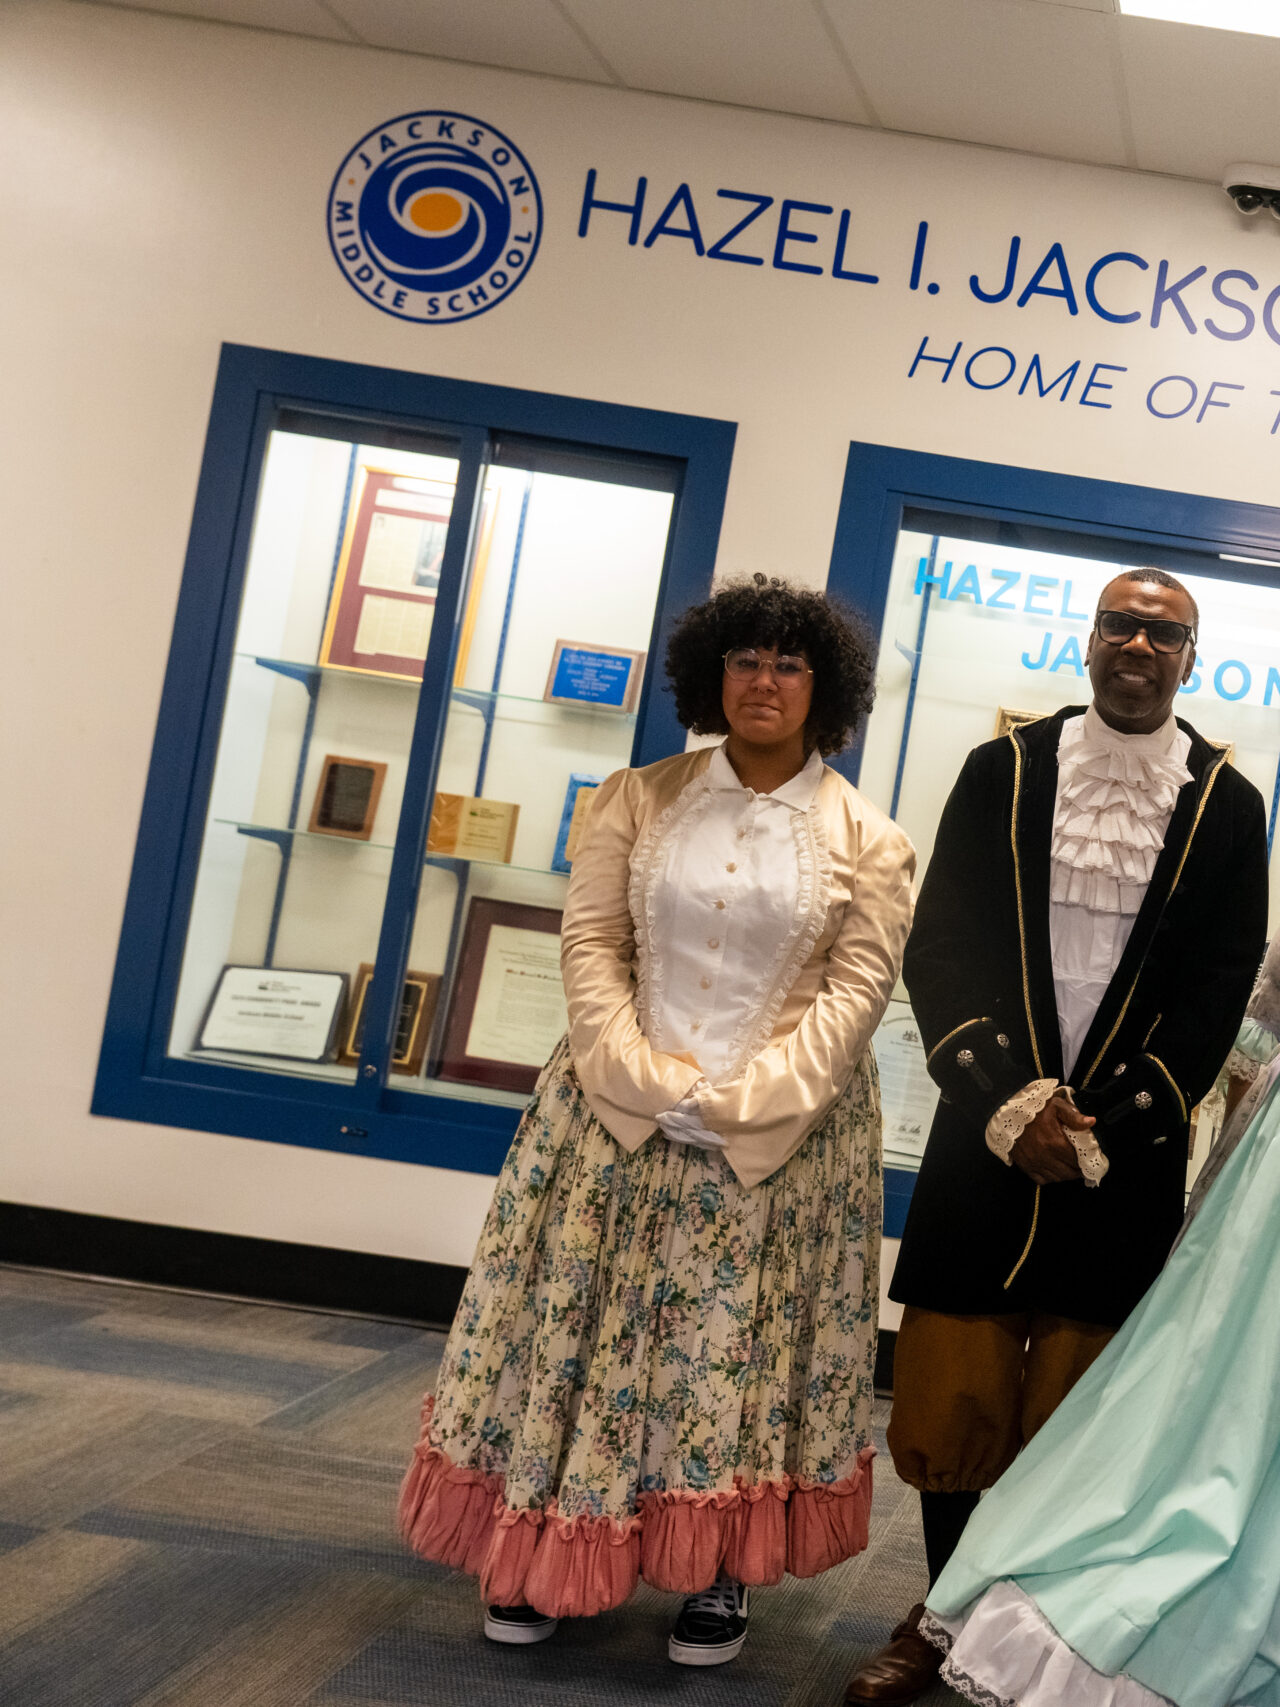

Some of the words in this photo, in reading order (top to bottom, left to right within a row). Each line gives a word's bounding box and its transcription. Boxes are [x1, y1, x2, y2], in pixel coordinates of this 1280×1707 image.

[359, 119, 530, 197] JACKSON
[335, 200, 408, 310] MIDDLE
[427, 229, 533, 316] SCHOOL
[578, 168, 880, 285] HAZEL
[909, 221, 941, 296] I.
[907, 335, 1128, 409] HOME
[1146, 374, 1244, 423] OF
[913, 556, 1090, 621] HAZEL
